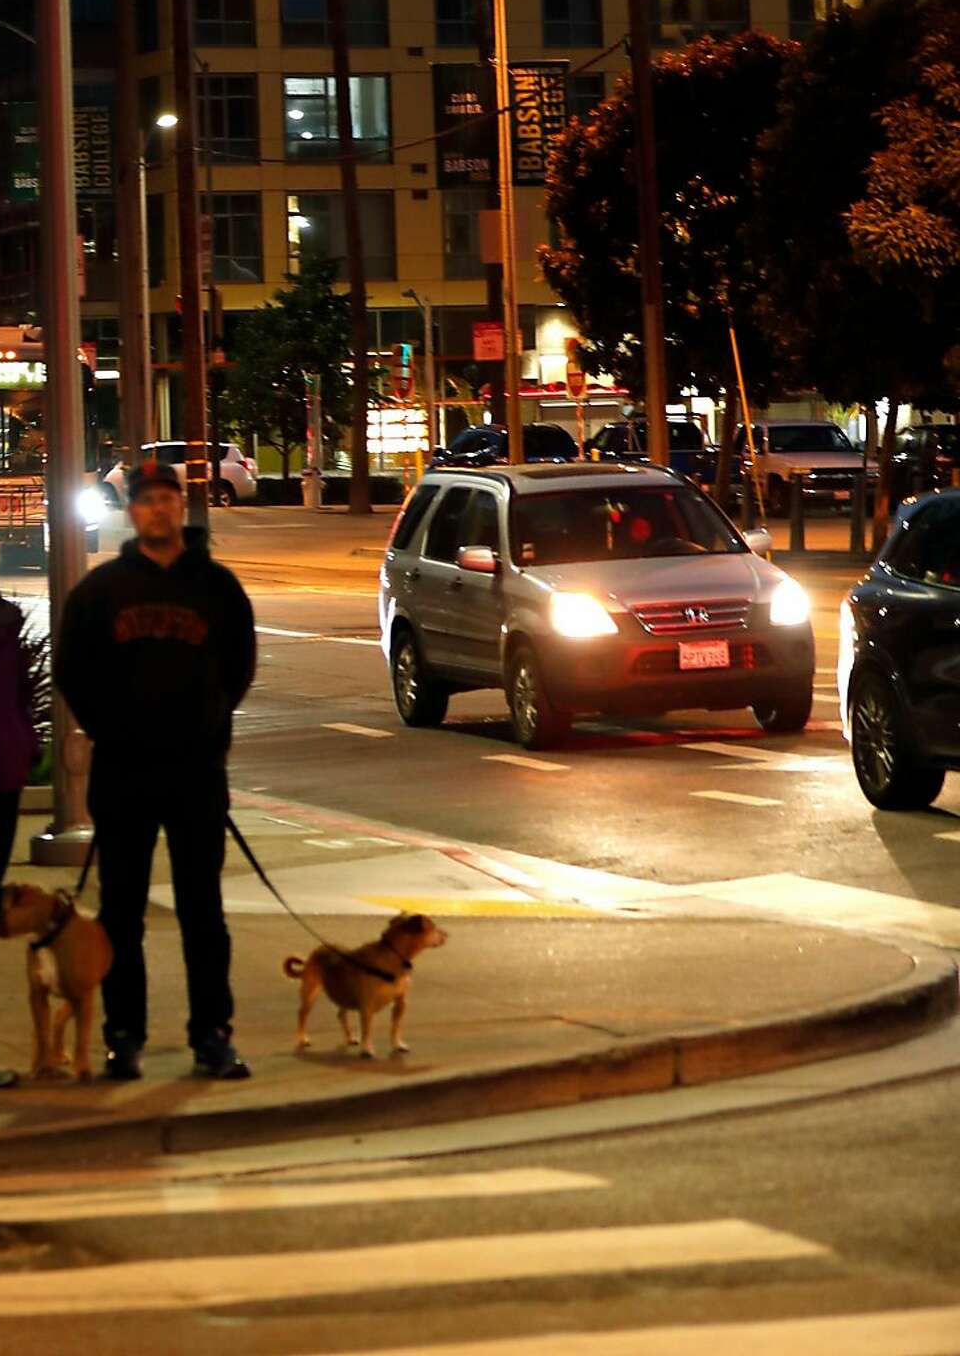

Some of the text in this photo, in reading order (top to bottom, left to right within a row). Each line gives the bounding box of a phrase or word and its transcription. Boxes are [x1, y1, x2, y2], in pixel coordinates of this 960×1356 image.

[74, 111, 91, 188] BABSON
[91, 111, 112, 188] COLLEGE
[512, 75, 543, 171] BABSON
[13, 177, 41, 189] BABS
[443, 158, 489, 172] BABSON
